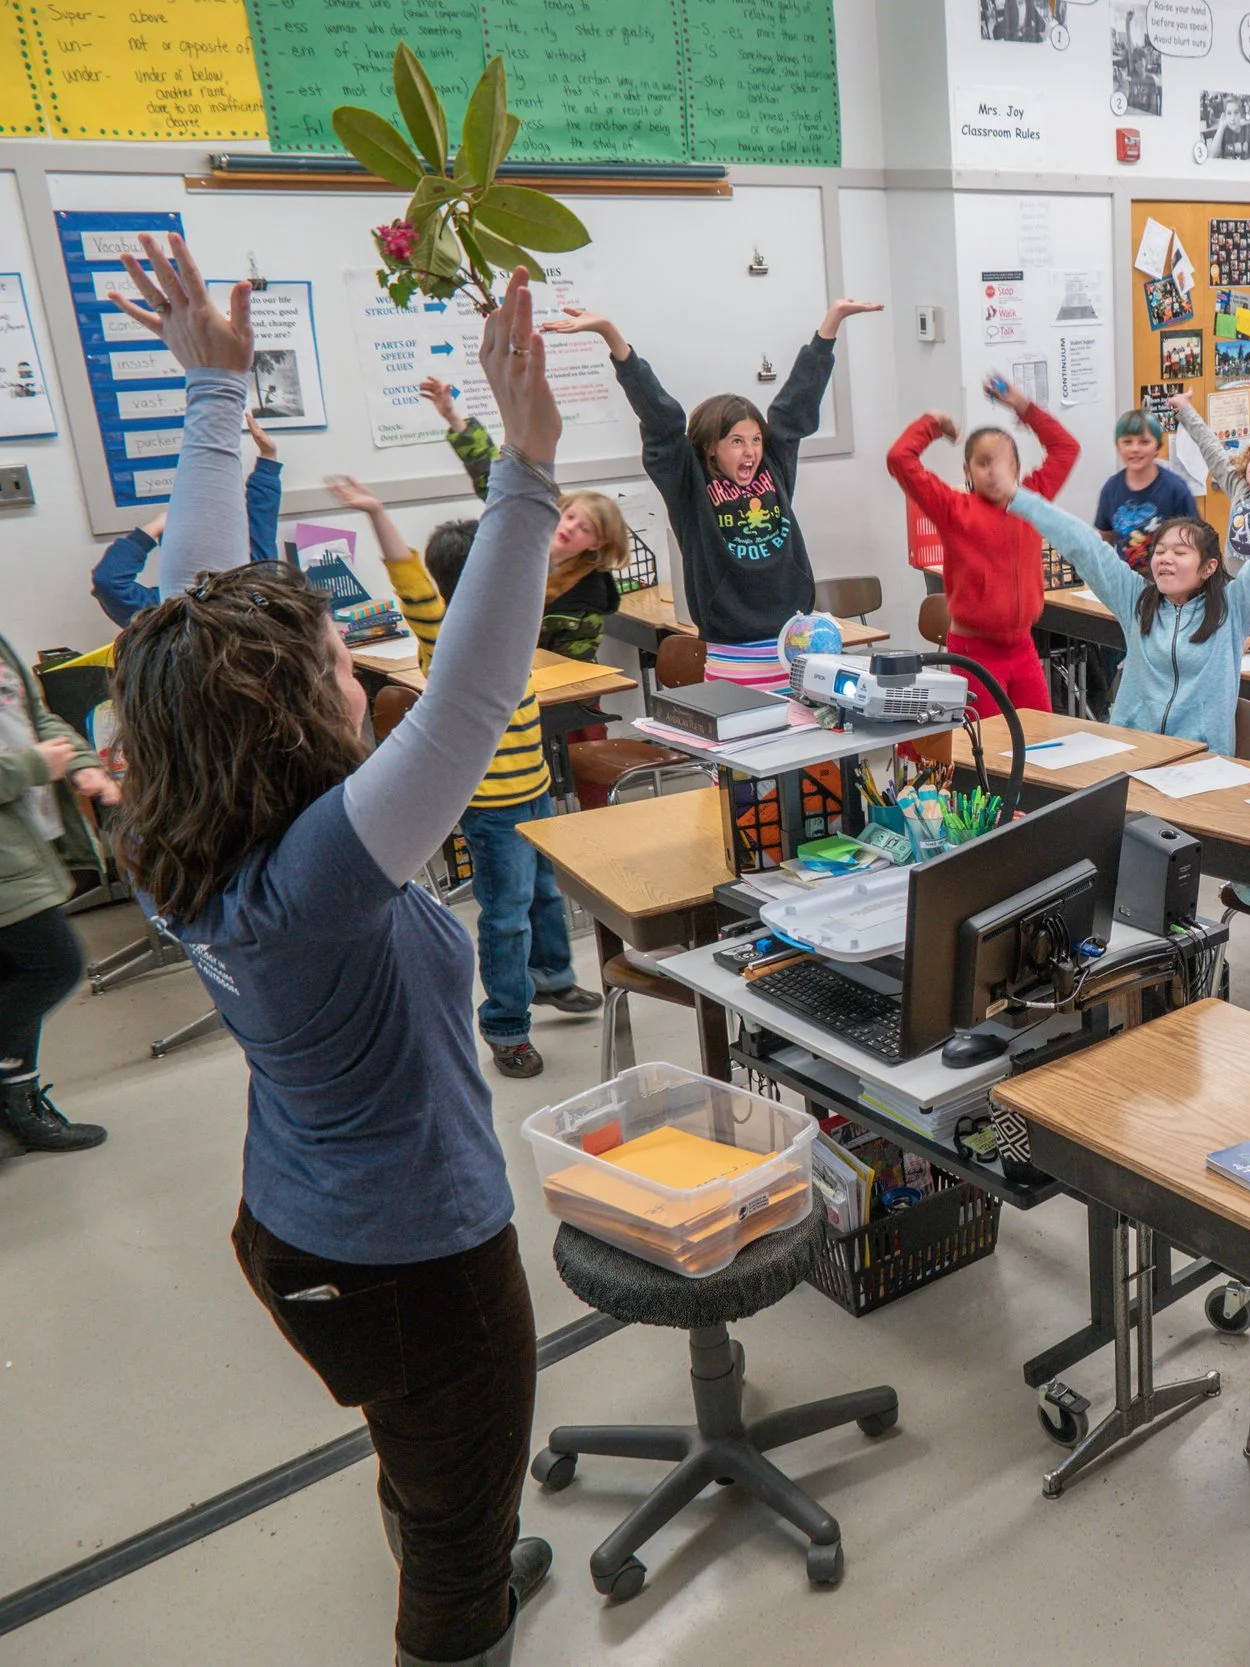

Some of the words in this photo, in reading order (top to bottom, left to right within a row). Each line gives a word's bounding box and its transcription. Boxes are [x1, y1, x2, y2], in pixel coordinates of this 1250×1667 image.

[129, 12, 168, 23] above
[365, 22, 385, 35] who
[390, 23, 409, 36] does
[575, 24, 600, 37] state
[606, 27, 617, 37] or
[622, 25, 655, 45] quality
[756, 28, 775, 39] more
[782, 30, 799, 41] than
[803, 34, 817, 43] one
[1153, 34, 1172, 44] Avoid
[129, 33, 149, 50] not
[179, 37, 228, 59] opposite
[236, 36, 253, 55] of
[546, 50, 587, 63] without
[803, 52, 814, 63] to
[563, 75, 570, 83] a
[342, 83, 367, 97] most
[748, 79, 784, 93] particular
[155, 87, 193, 100] another
[147, 103, 169, 116] done
[175, 102, 185, 114] to
[188, 104, 202, 114] an
[562, 99, 577, 115] the
[584, 103, 598, 115] act
[623, 104, 649, 117] result
[654, 105, 664, 116] of
[1115, 98, 1123, 110] 2
[978, 103, 1001, 116] Mrs.
[1006, 105, 1025, 119] Joy
[166, 116, 201, 134] degree
[566, 118, 581, 131] the
[590, 117, 627, 132] condition
[633, 119, 642, 131] of
[650, 118, 671, 136] being
[961, 125, 1012, 139] Classroom
[1015, 126, 1041, 140] Rules
[570, 133, 583, 149] the
[623, 139, 634, 152] of
[738, 138, 764, 155] having
[998, 286, 1013, 298] Stop
[279, 308, 298, 318] good
[999, 309, 1017, 318] Walk
[269, 320, 297, 329] change
[1000, 325, 1015, 335] Talk
[374, 341, 402, 351] PARTS
[381, 351, 415, 362] SPEECH
[117, 358, 158, 370] insist
[386, 362, 414, 373] CLUES
[1060, 337, 1070, 399] CONTINUUM
[392, 396, 419, 406] CLUES
[718, 514, 734, 528] 18
